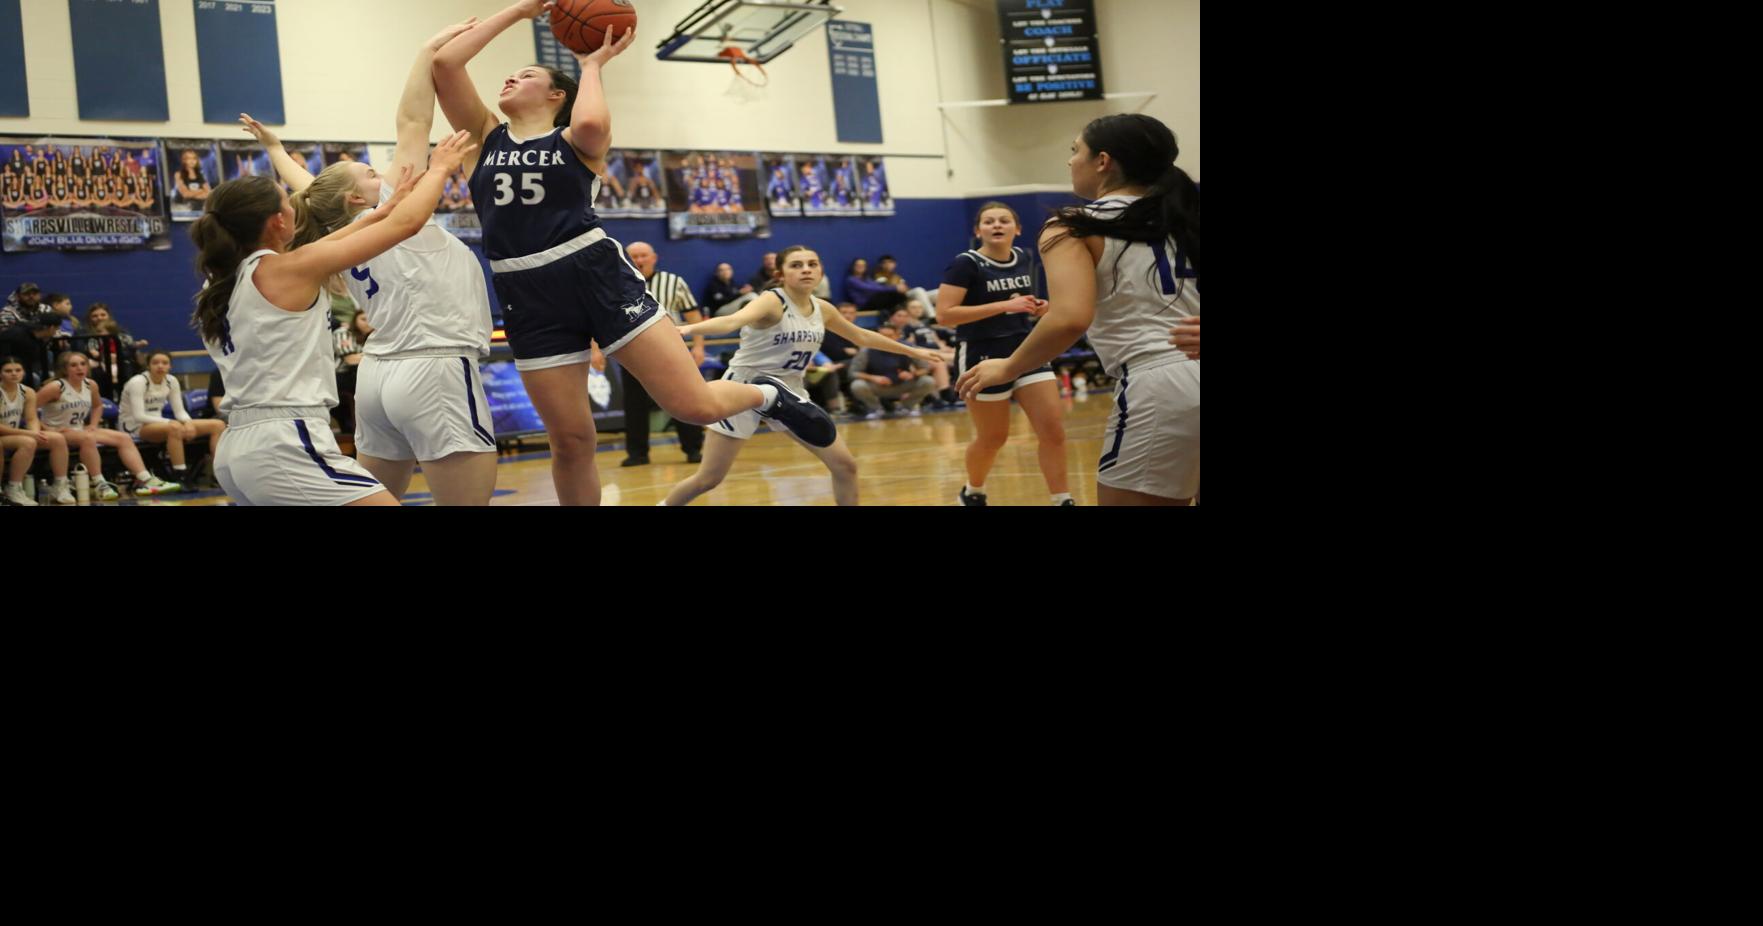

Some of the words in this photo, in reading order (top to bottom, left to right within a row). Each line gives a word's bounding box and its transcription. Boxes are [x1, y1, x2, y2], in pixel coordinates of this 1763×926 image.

[1024, 26, 1073, 36] COACH
[1012, 53, 1092, 64] OFFICIATE
[1015, 82, 1033, 92] BE
[1036, 80, 1096, 91] POSITIVE
[483, 149, 566, 166] MERCER
[494, 172, 545, 206] 35
[7, 217, 93, 234] SARPSVILLE
[57, 236, 84, 244] BLUE
[782, 351, 812, 370] 20
